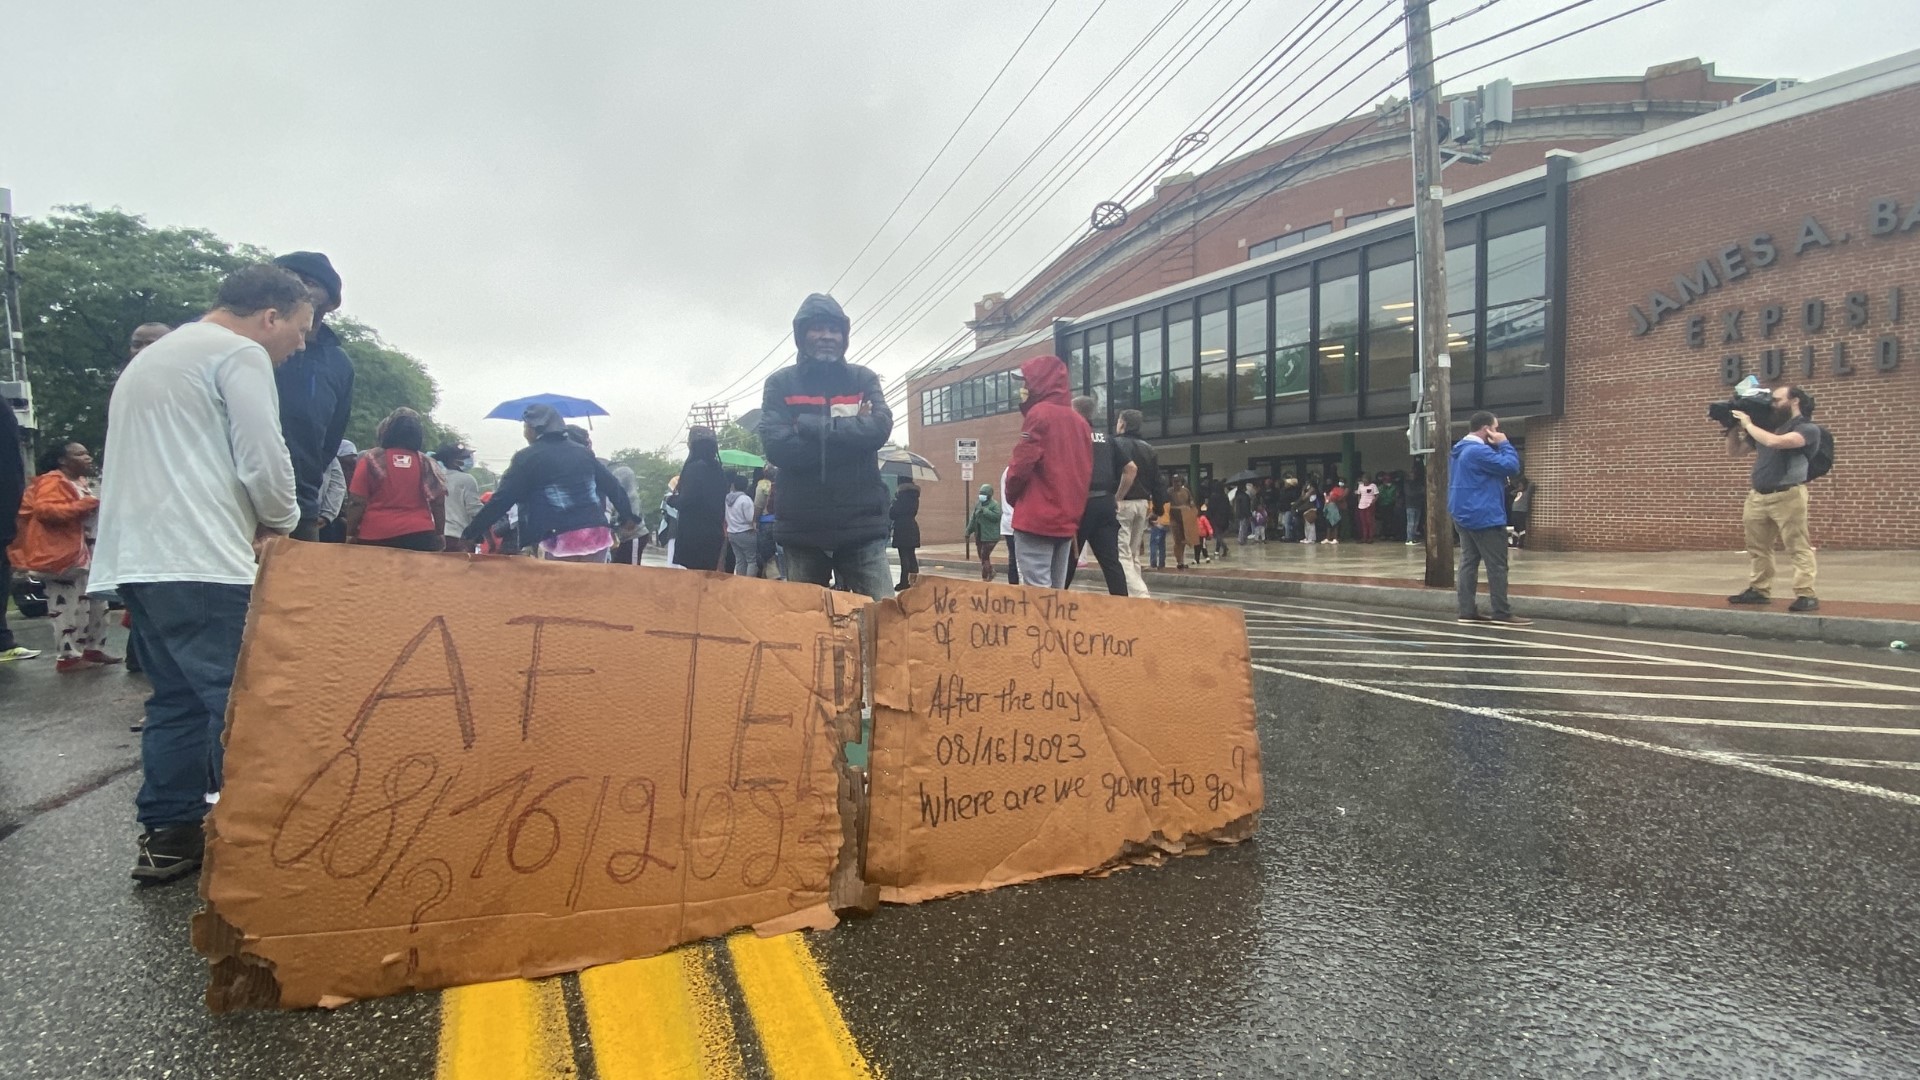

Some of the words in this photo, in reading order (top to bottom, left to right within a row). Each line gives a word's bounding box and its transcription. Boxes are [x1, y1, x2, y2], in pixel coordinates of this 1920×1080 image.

[1629, 232, 1776, 337] JAMES
[1687, 286, 1900, 347] EXPOSI
[1722, 335, 1898, 384] BUILD
[933, 586, 958, 615] We
[1025, 624, 1139, 669] governor
[342, 613, 862, 804] AFTER
[928, 673, 989, 726] After
[993, 678, 1035, 713] the
[1041, 678, 1081, 722] day
[936, 726, 1087, 766] 08/16/2023
[919, 776, 998, 828] Where
[1003, 785, 1047, 811] are
[1101, 772, 1161, 813] going
[1166, 768, 1195, 796] to
